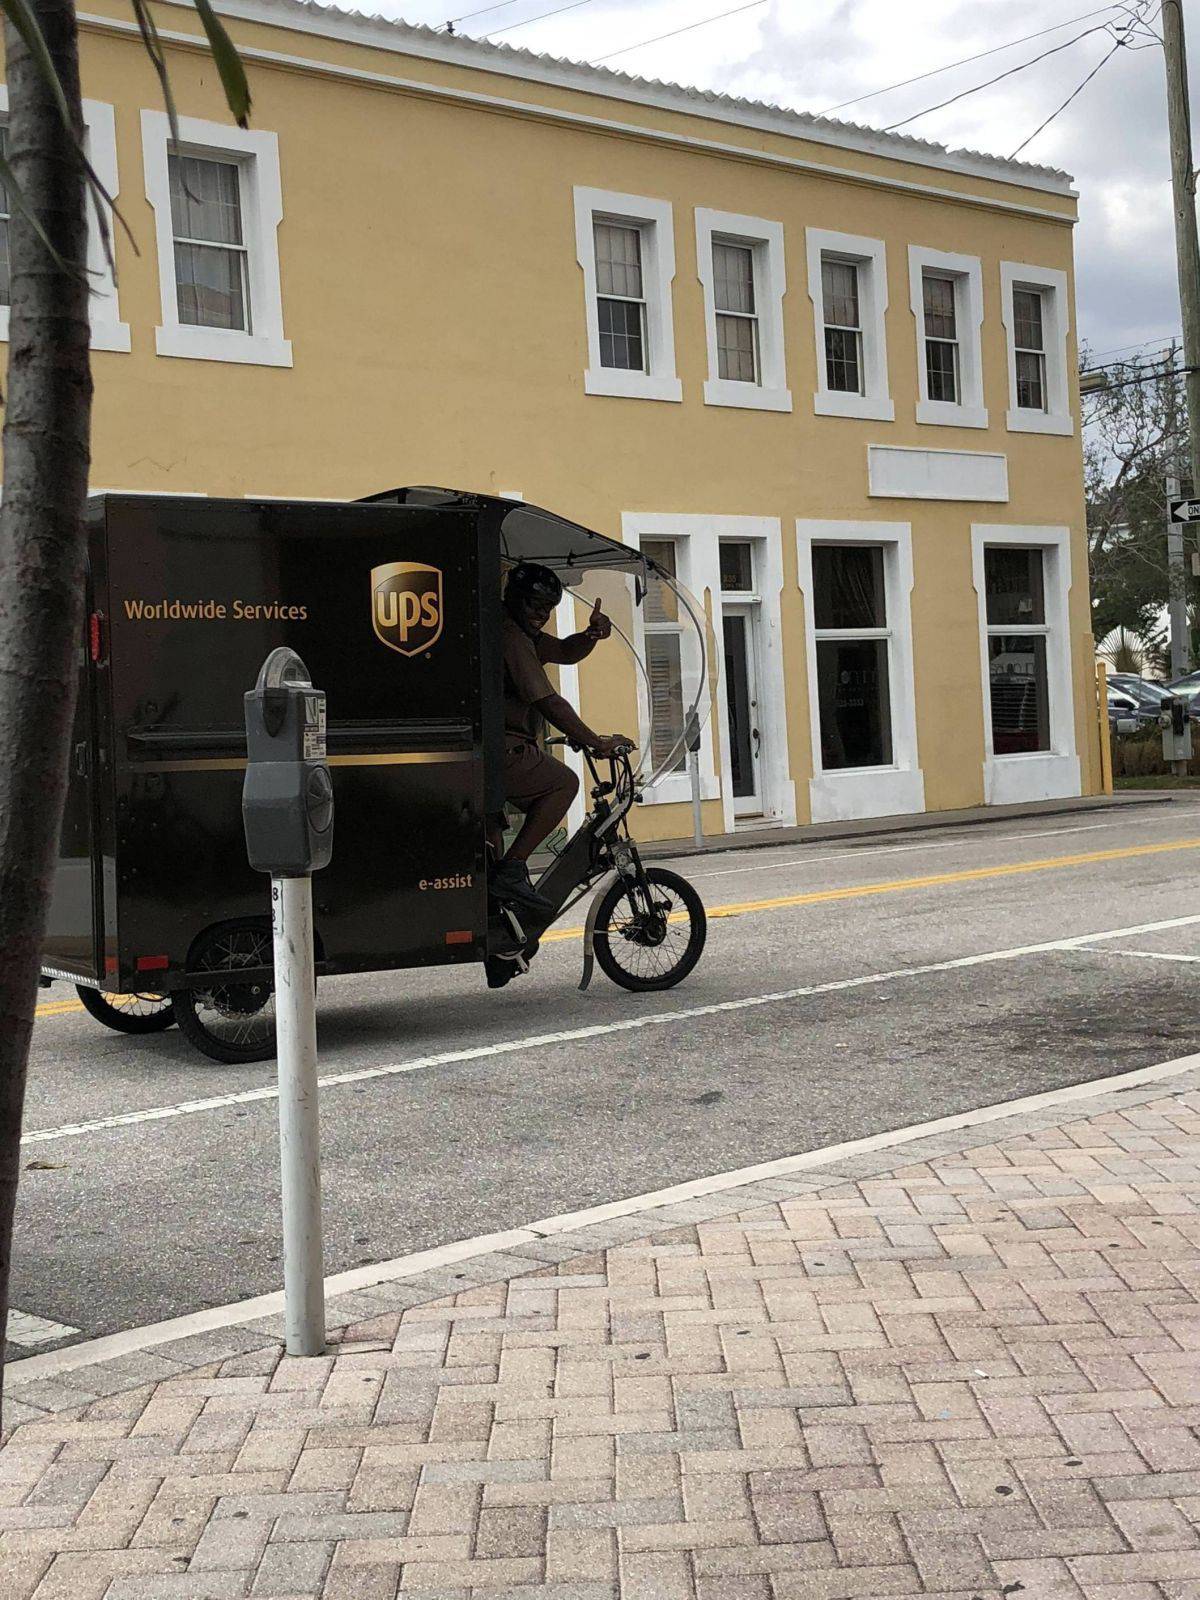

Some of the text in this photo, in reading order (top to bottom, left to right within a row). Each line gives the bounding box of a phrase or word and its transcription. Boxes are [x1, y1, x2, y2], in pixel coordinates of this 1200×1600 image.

[123, 600, 308, 620] Worldwide Services
[419, 873, 472, 891] e-assist
